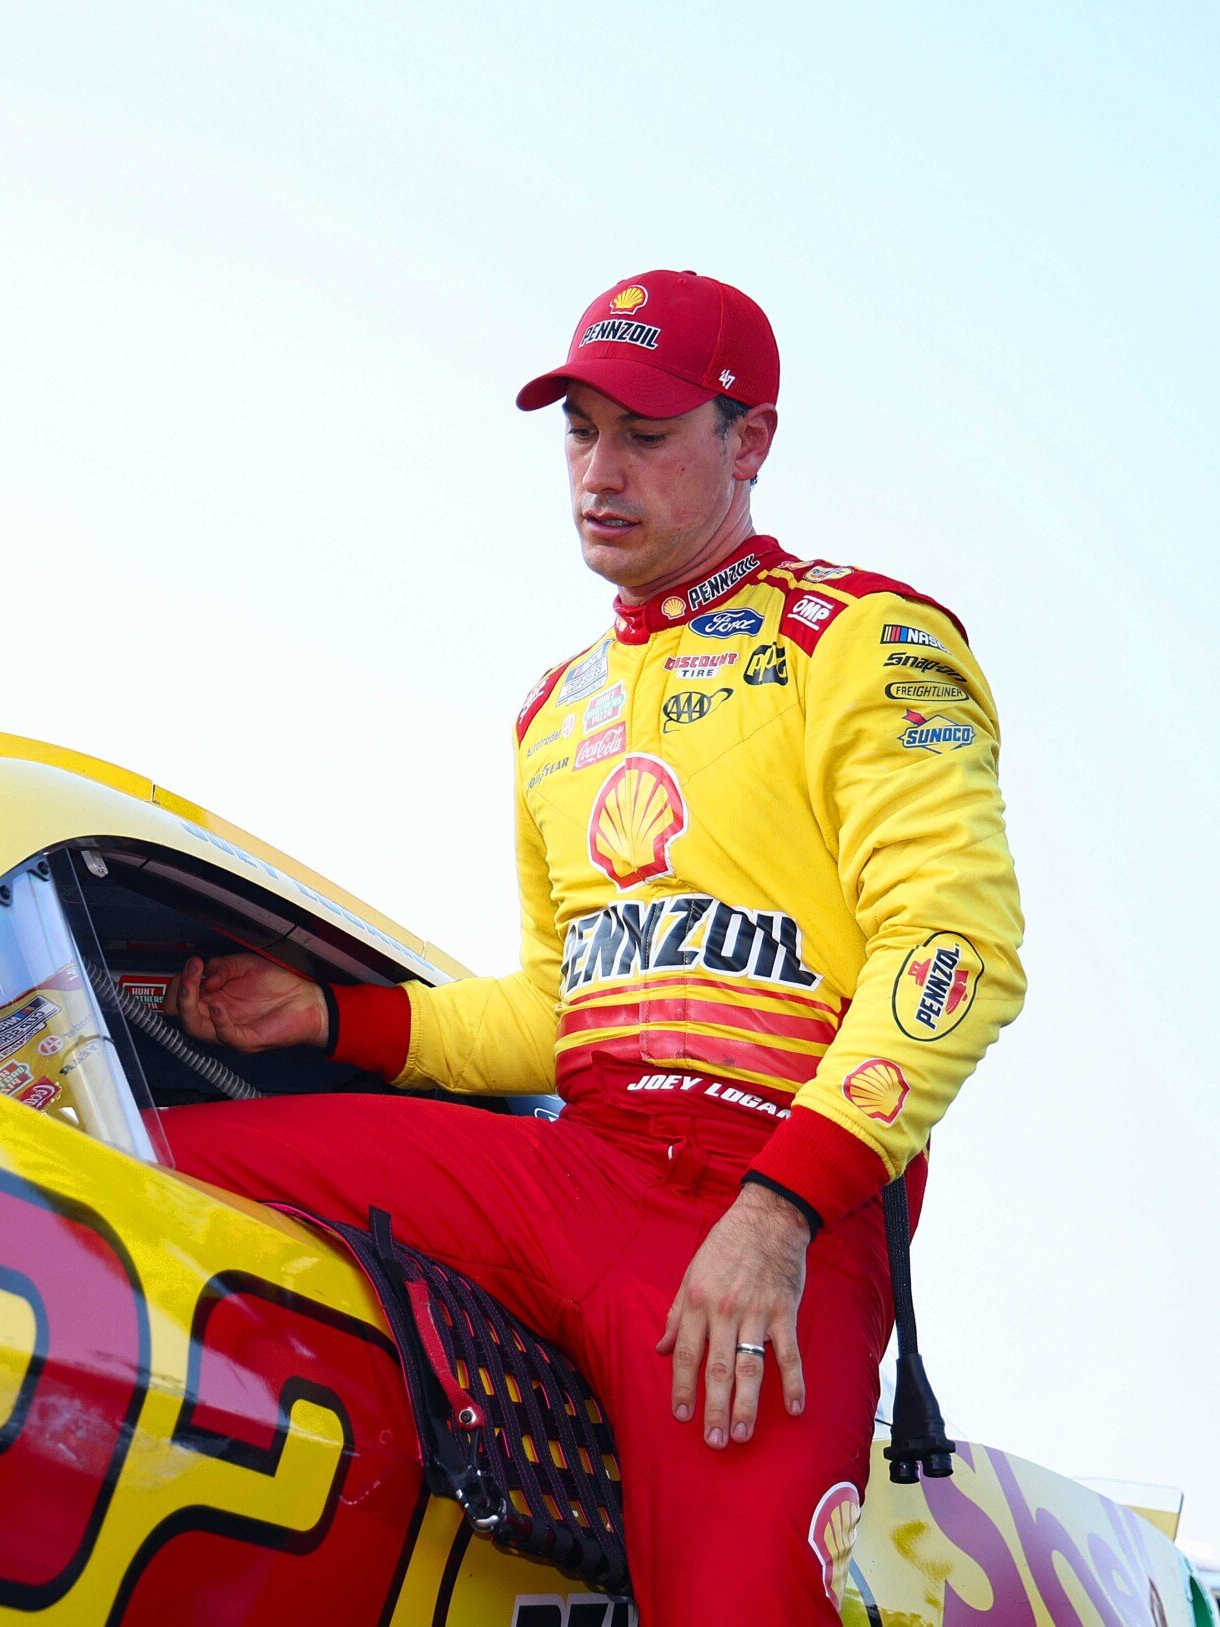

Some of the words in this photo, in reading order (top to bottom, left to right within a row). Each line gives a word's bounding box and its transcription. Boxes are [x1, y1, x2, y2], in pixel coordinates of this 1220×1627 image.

[580, 319, 661, 350] PENNZOIL
[688, 553, 760, 611] PENNZOIL
[793, 599, 830, 623] OMP
[705, 612, 756, 633] Ford
[664, 653, 737, 670] DISCOUNT
[682, 669, 714, 677] TIRE
[895, 685, 963, 698] FREIGHTLINER
[669, 692, 707, 722] AAA
[906, 728, 970, 743] SUNOCO
[627, 1074, 703, 1091] JOEY
